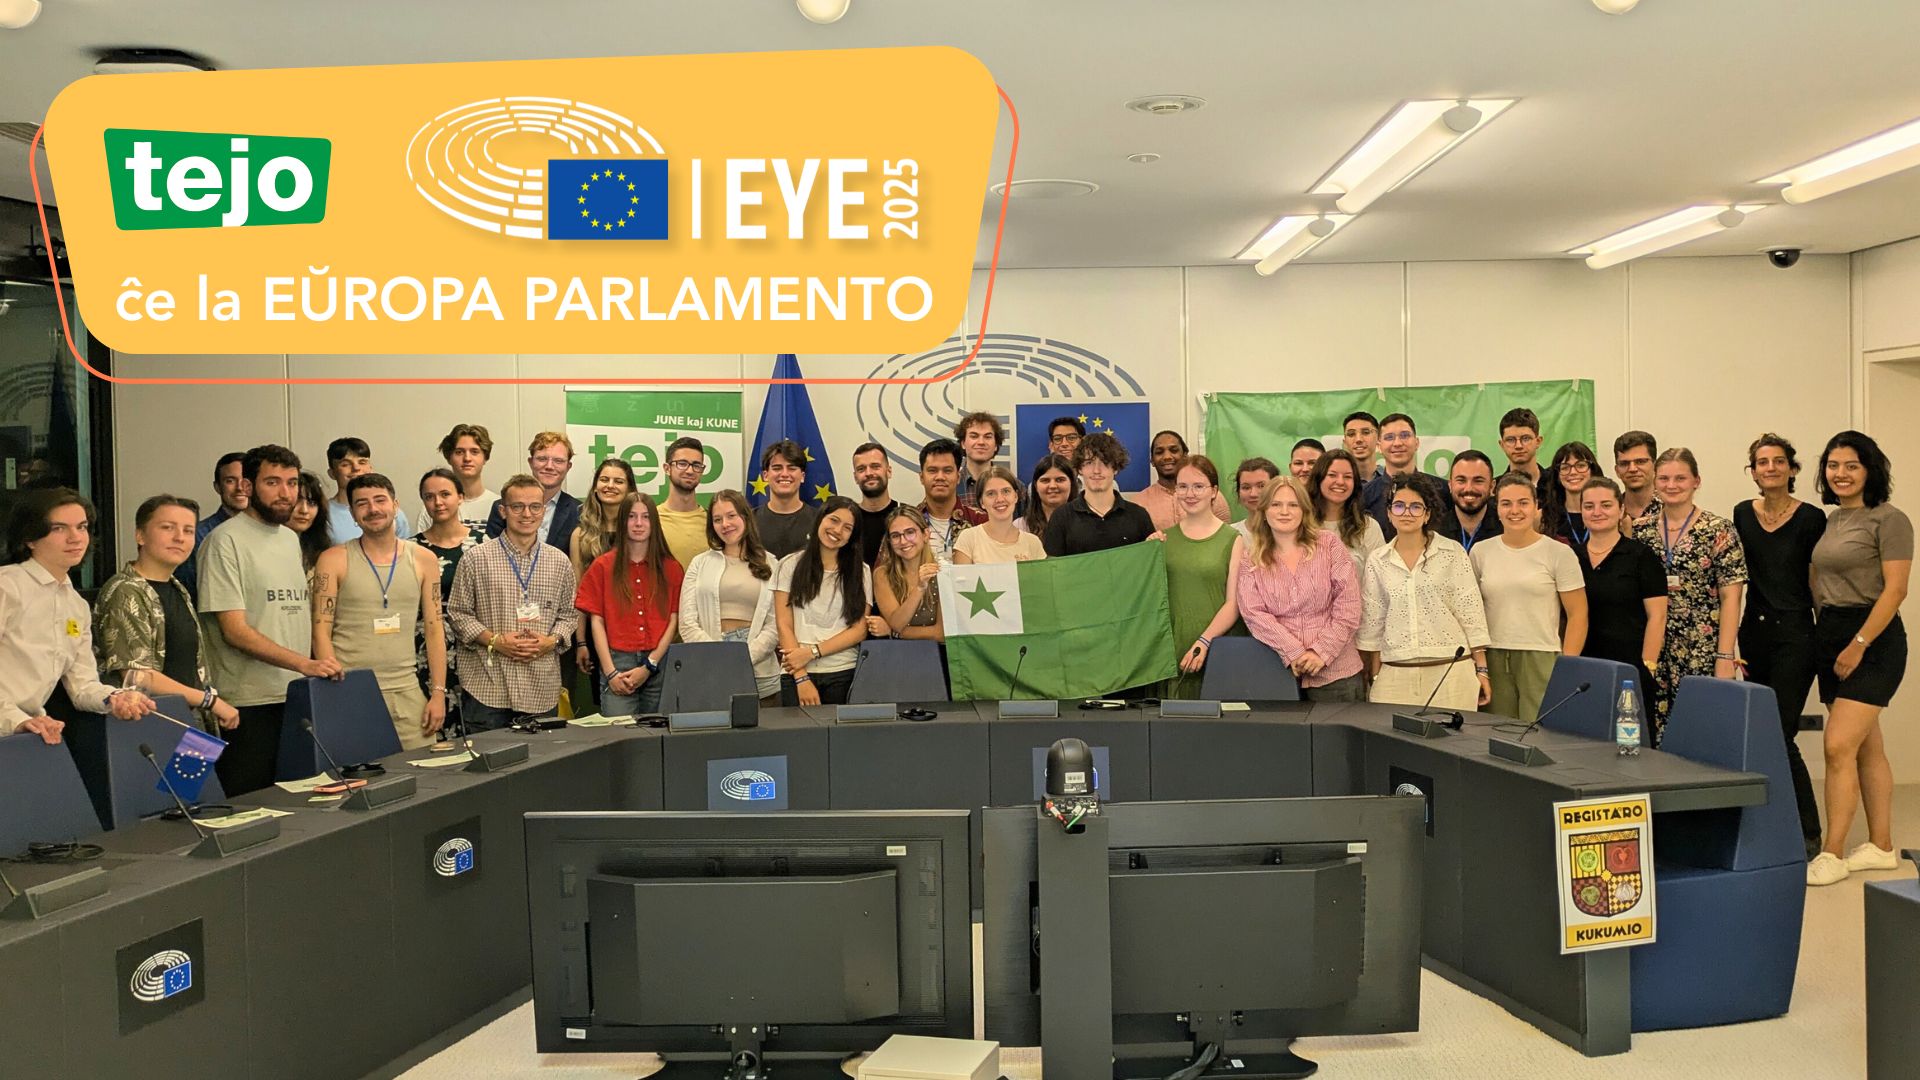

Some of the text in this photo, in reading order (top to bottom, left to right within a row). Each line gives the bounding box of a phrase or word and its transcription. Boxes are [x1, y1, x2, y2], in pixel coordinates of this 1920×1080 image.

[653, 415, 739, 429] JUNE kaj KUNE
[1576, 923, 1642, 942] KUKUMIO
